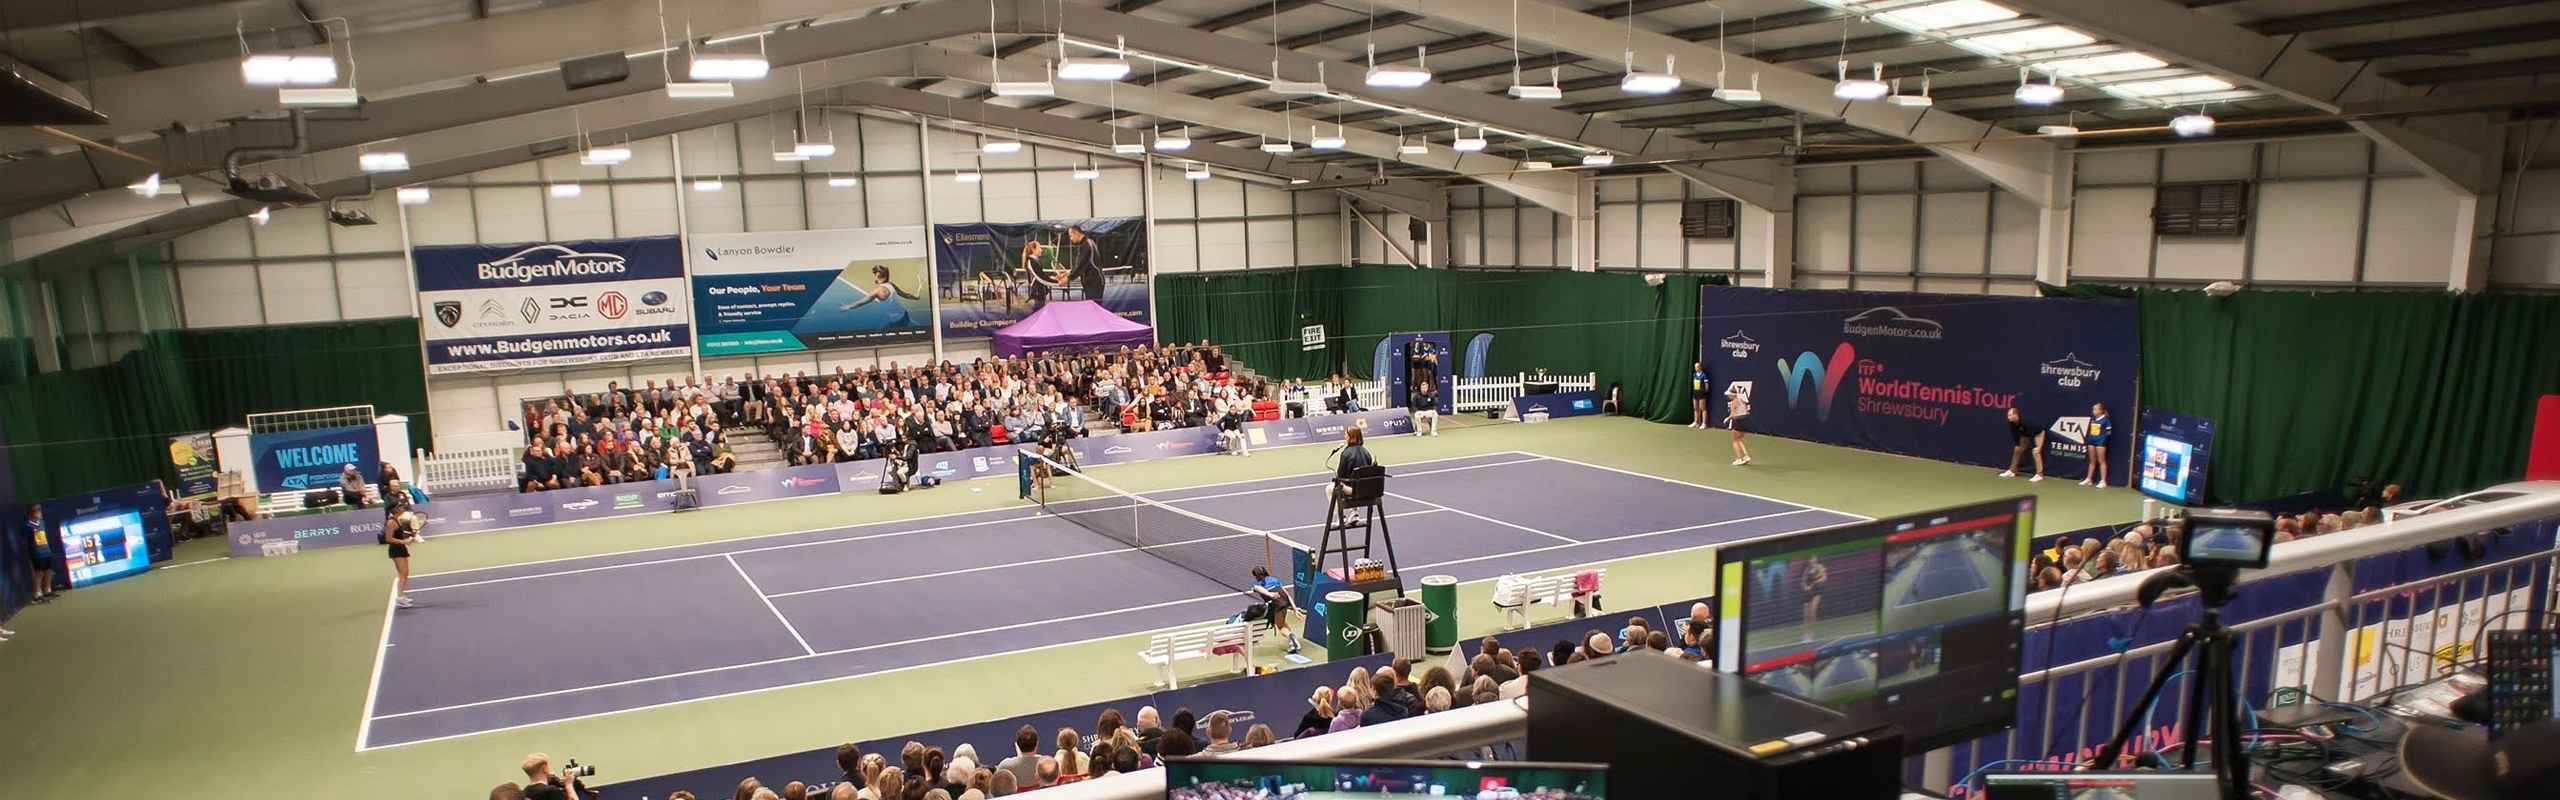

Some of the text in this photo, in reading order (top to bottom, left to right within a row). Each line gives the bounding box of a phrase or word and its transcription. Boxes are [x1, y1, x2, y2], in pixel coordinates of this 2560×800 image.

[718, 245, 795, 257] Lanyon Bowdler
[477, 259, 626, 283] BudgenMotors
[709, 283, 806, 295] Our People, Your Team
[601, 294, 624, 317] MG
[636, 307, 676, 316] SUBARU
[549, 313, 591, 321] DACIA
[949, 318, 1017, 329] Building Champions
[1304, 327, 1321, 335] FIRE
[1844, 322, 1942, 339] BudgenMotors.co.uk
[447, 329, 672, 357] www.Budgenmotors.co.uk
[1304, 334, 1321, 343] EXIT
[620, 352, 635, 360] AND
[1732, 349, 1748, 358] club
[1858, 364, 1876, 375] ITF
[2058, 376, 2081, 387] club
[1858, 396, 1950, 426] Shrewsbury
[1316, 425, 1344, 433] MORRIS
[2060, 421, 2084, 436] LTA
[2051, 442, 2087, 453] TENNIS
[275, 443, 359, 469] WELCOME
[294, 527, 340, 539] BERRYS
[81, 535, 93, 548] 15
[85, 552, 96, 564] 15
